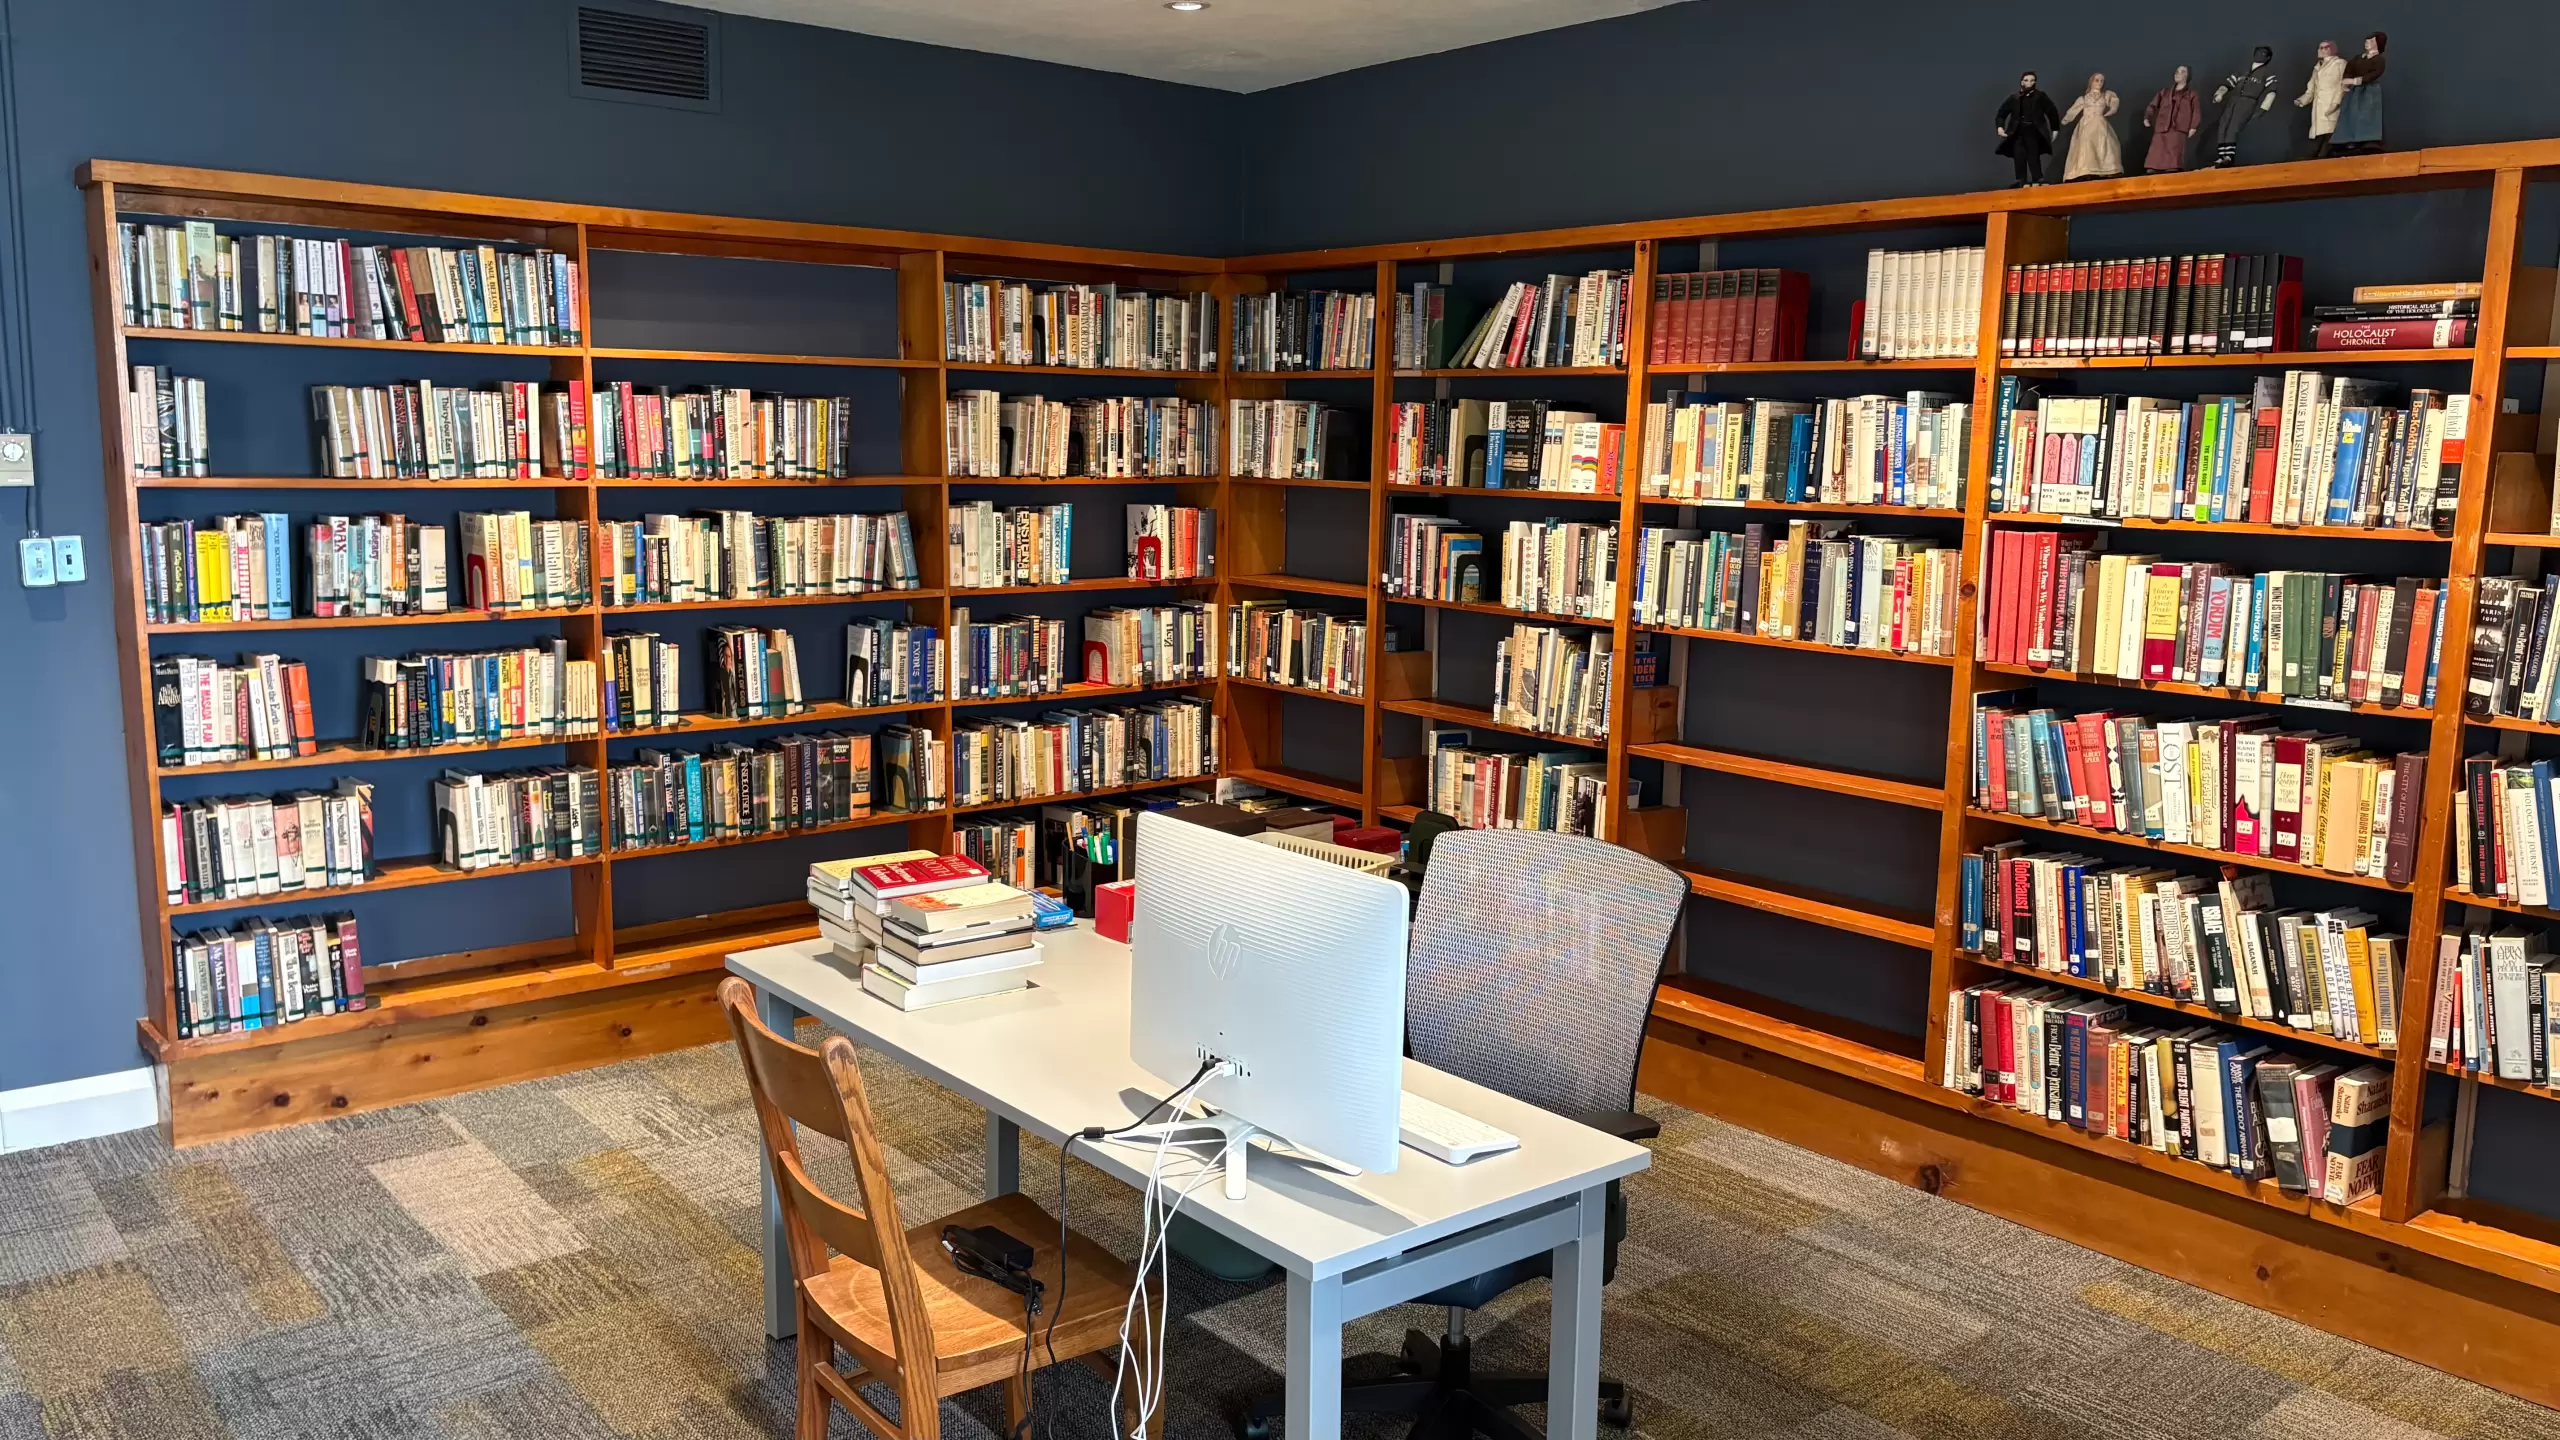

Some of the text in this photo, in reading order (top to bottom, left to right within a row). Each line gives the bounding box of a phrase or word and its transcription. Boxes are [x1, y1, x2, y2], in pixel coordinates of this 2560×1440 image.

[466, 254, 476, 290] HERZOG
[487, 260, 498, 314] SAUL BELLOW
[2333, 328, 2396, 338] HOLOCAUST
[2340, 338, 2386, 346] CHRONICLE
[441, 397, 451, 438] Thirty-four
[2446, 399, 2463, 437] Auschwitz
[1486, 432, 1495, 466] Dictionary
[1930, 454, 1938, 479] ISRAEL
[2401, 458, 2414, 485] Yigael
[334, 520, 346, 553] MAX
[370, 529, 379, 560] Legacy
[488, 532, 498, 564] HILLTOP
[1021, 511, 1029, 562] EINSTEIN
[546, 527, 562, 587] The Rabbi
[1910, 565, 1920, 634] SHADOW PEOPLE
[2037, 546, 2051, 632] Where Once We Walked
[2197, 569, 2208, 596] VICHY
[2271, 586, 2282, 603] NONE
[2193, 597, 2205, 627] FRANCE
[2206, 590, 2227, 639] YORDIM
[2271, 611, 2281, 623] TOO
[2191, 629, 2199, 640] and
[2191, 641, 2199, 651] the
[2270, 624, 2281, 641] MANY
[912, 641, 920, 677] EXODUS
[2189, 651, 2198, 673] JEWS
[264, 660, 282, 725] Promise the Earth
[739, 681, 745, 689] OF
[1596, 662, 1607, 710] MOE BERG
[200, 672, 213, 743] THE MASADA PLAN
[416, 671, 430, 738] franz kafka
[1977, 712, 1986, 748] Pioneers
[663, 765, 671, 786] WIESEL
[1978, 759, 1986, 781] Israel
[2163, 731, 2182, 789] LOST
[678, 788, 687, 799] THE
[2201, 751, 2213, 826] THE GRANDEES
[336, 803, 344, 812] The
[2318, 771, 2331, 844] The Magic Carpet
[2524, 792, 2538, 876] HOLOCAUST JOURNEY
[918, 859, 954, 877] ROTH
[2014, 861, 2030, 909] Holocaust
[2161, 888, 2181, 955] THE CONQUERORS
[213, 946, 227, 990] My Michael
[1212, 922, 1242, 980] hp
[2247, 942, 2258, 975] HAGANAH
[2322, 948, 2339, 1015] DAYS OF LEAD
[2334, 964, 2349, 1017] DAYS OF LEAD
[2342, 966, 2356, 1018] DAYS OF LEAD
[2377, 954, 2391, 1027] FROM TIME IMMEMORIAL
[2016, 1004, 2026, 1088] The Jews in America
[2049, 1044, 2062, 1067] Beirut
[2051, 1068, 2057, 1076] TO
[2367, 1081, 2387, 1097] Natan
[2046, 1076, 2062, 1111] Jerusalem
[2176, 1063, 2191, 1137] HITLER'S SILENT PARTNERS
[2335, 1086, 2344, 1119] Sharansky
[2356, 1154, 2379, 1178] FEAR
[2347, 1180, 2362, 1198] NO
